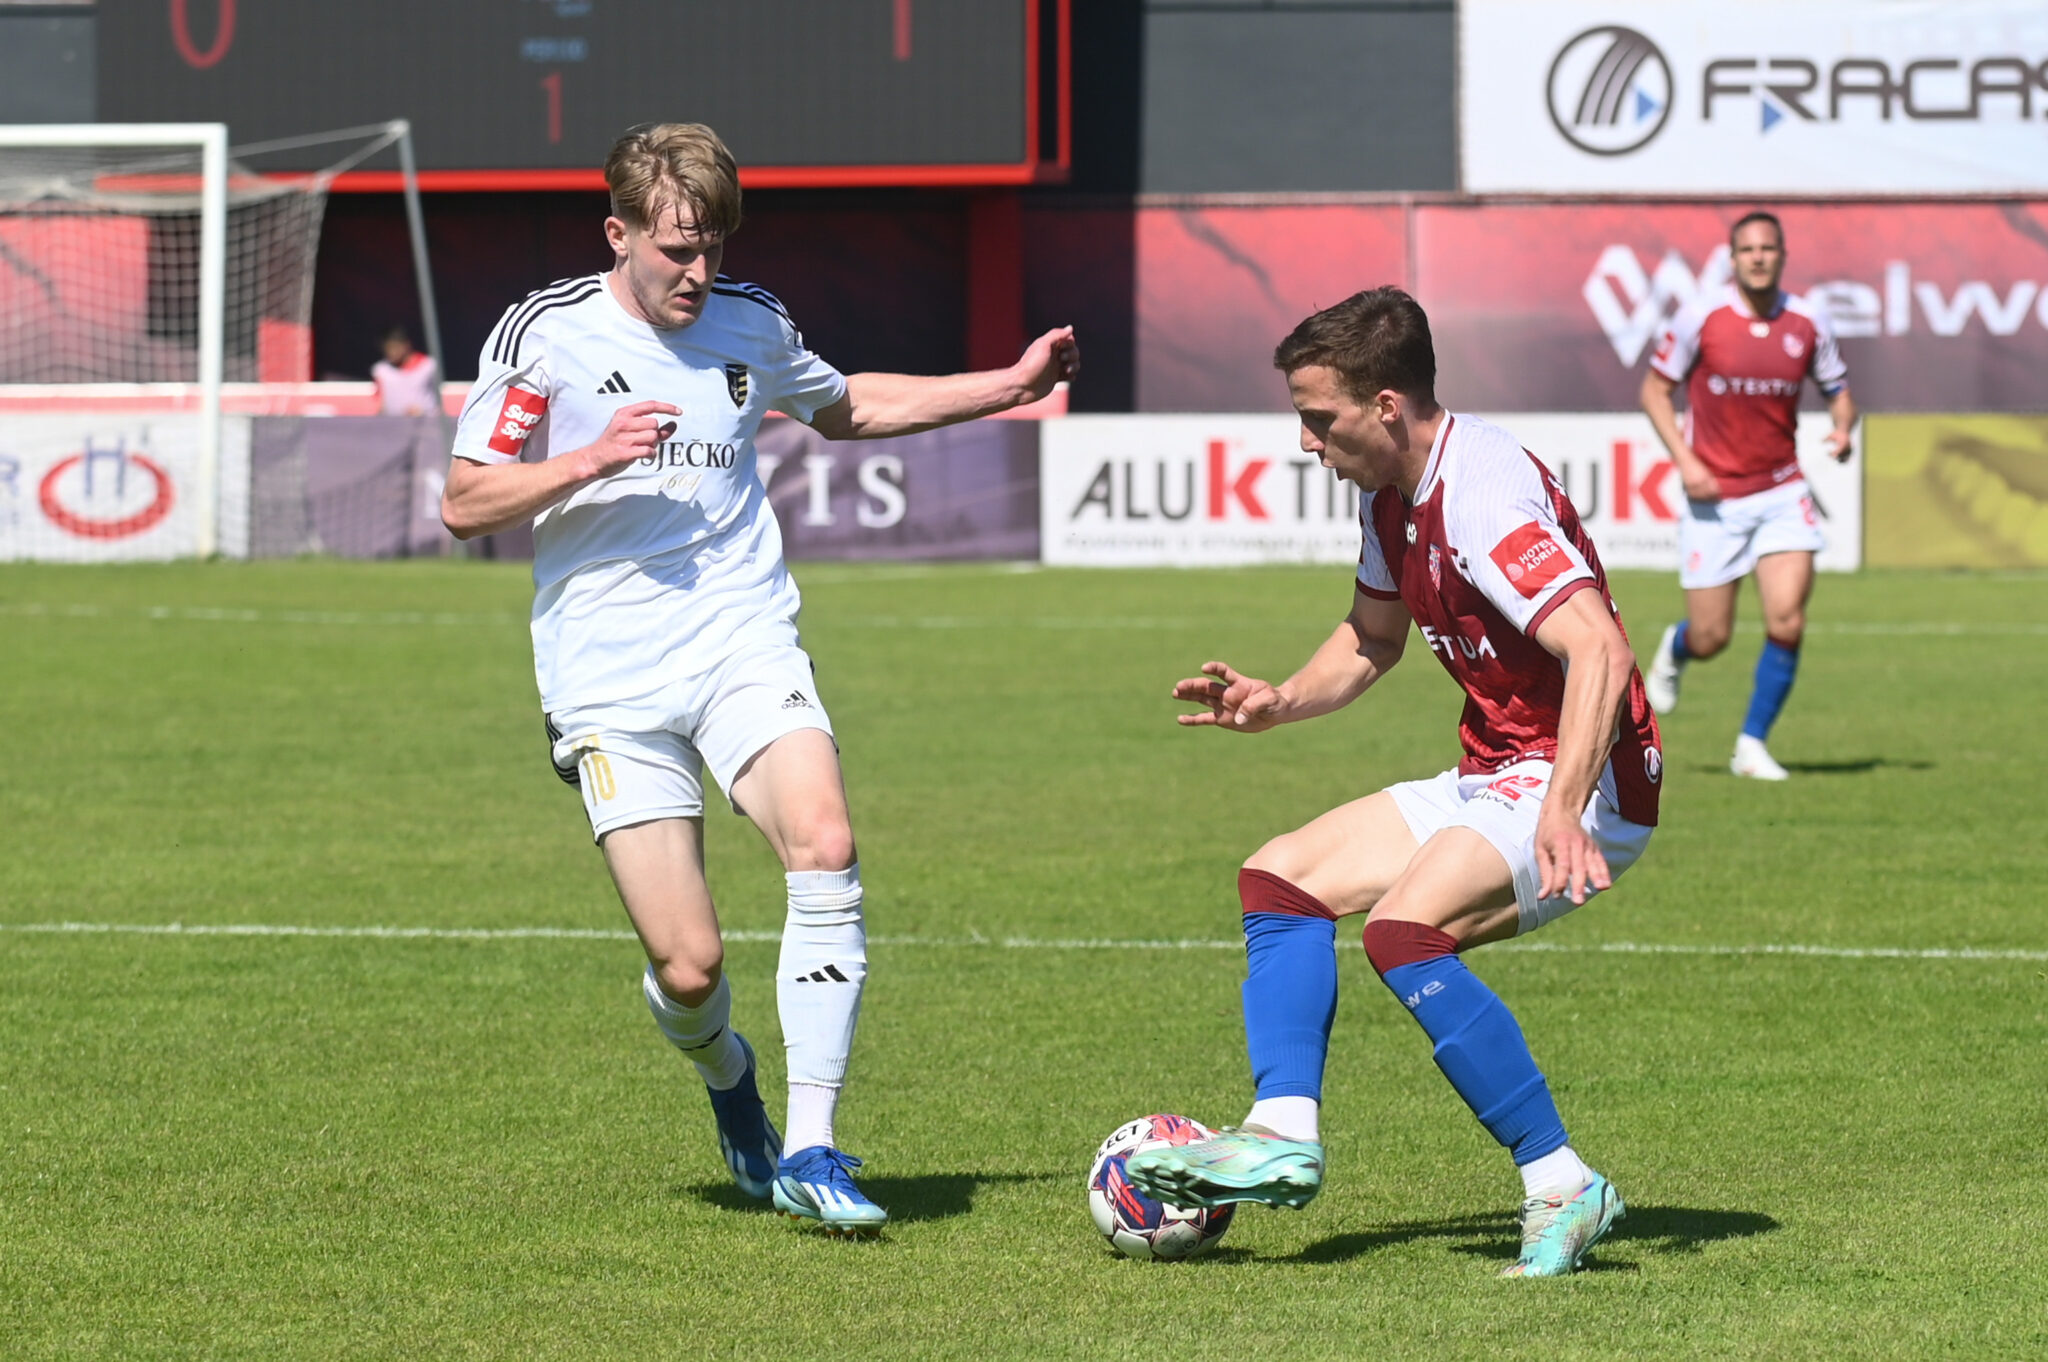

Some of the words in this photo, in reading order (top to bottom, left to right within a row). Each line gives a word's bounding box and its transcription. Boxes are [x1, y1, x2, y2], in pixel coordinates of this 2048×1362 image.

[541, 73, 561, 143] 1
[1518, 538, 1554, 565] HOTEL
[1526, 544, 1560, 572] ADRIA
